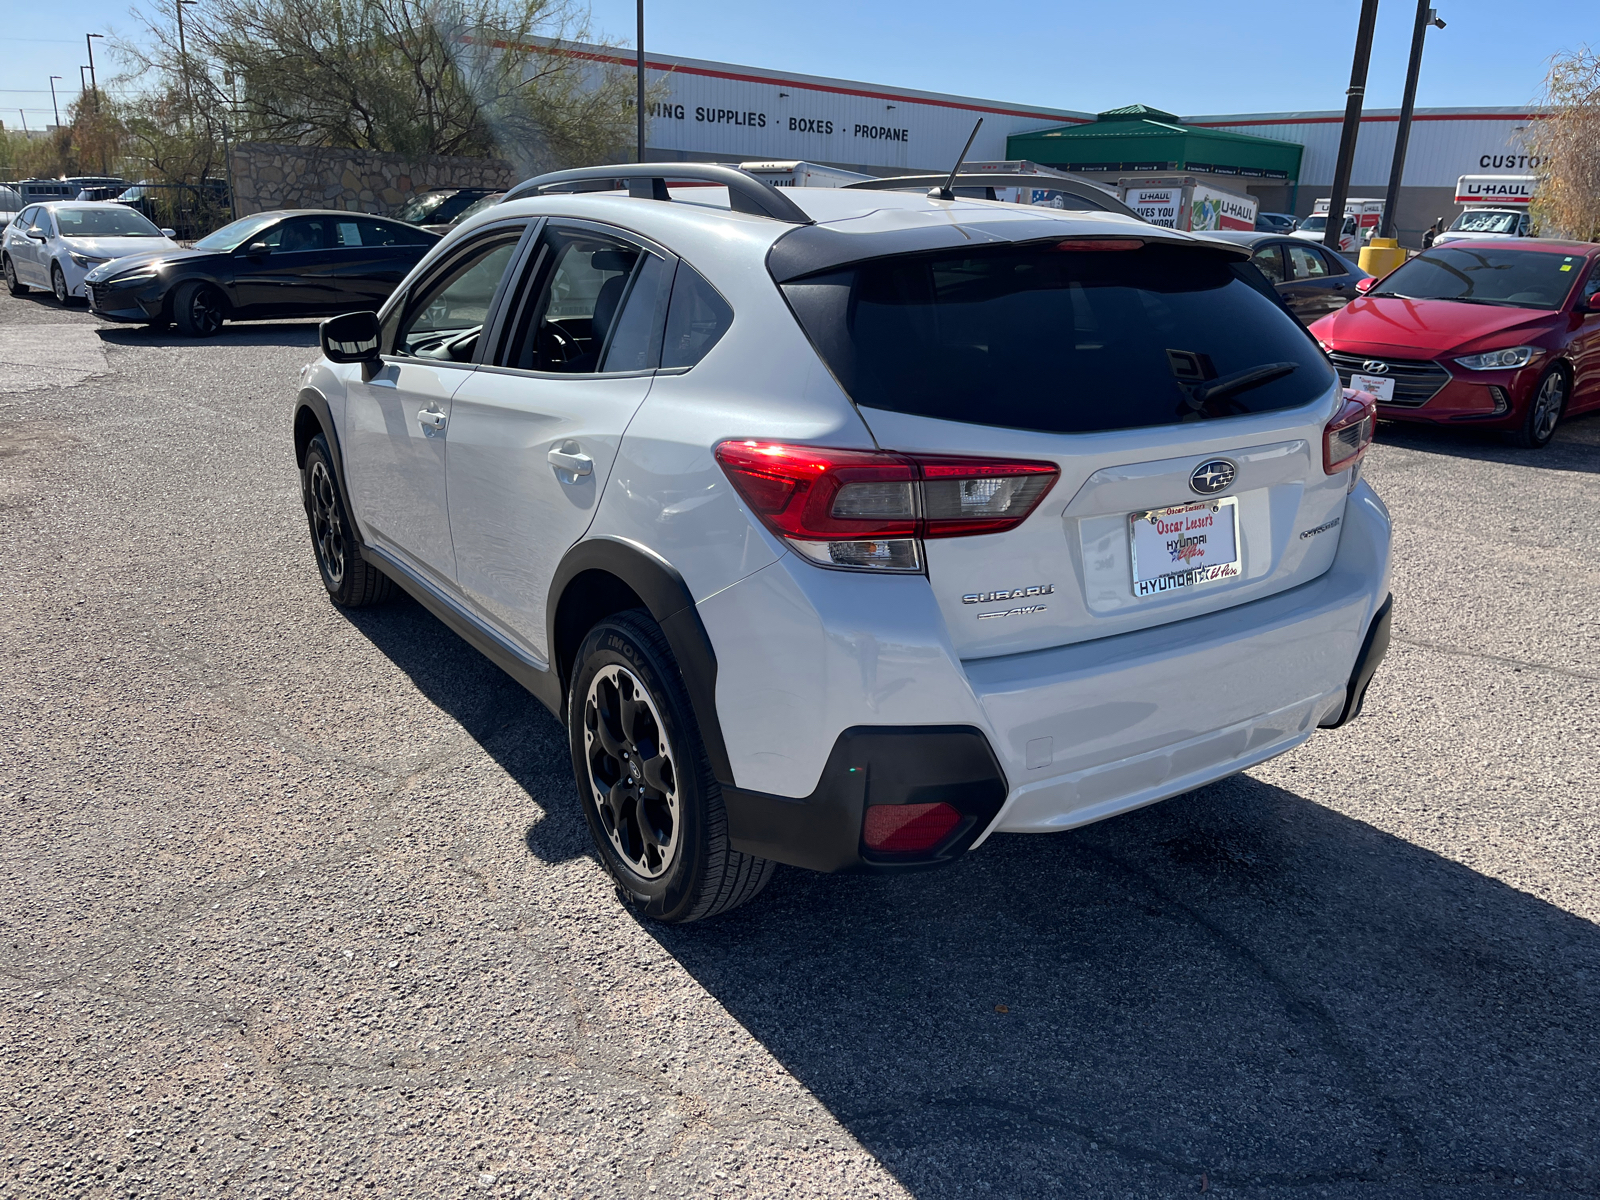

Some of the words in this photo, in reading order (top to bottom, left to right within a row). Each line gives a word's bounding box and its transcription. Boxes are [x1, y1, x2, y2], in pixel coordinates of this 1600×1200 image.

[695, 106, 767, 128] SUPPLIES
[789, 117, 833, 135] BOXES
[854, 124, 909, 142] PROPANE
[1480, 155, 1546, 169] CUSTO
[1468, 184, 1529, 195] U-HAUL
[1158, 207, 1175, 217] YOU
[1221, 200, 1253, 221] U-HAUL
[1166, 506, 1184, 516] Oscar
[1156, 520, 1184, 535] Oscar
[1185, 513, 1213, 531] Leeser's
[1166, 534, 1207, 550] HYUNDAI
[1140, 571, 1198, 595] HYUNDAI
[1210, 566, 1221, 580] El
[1221, 564, 1238, 576] Paso
[962, 584, 1055, 604] SUBARU
[1004, 604, 1048, 616] AWD
